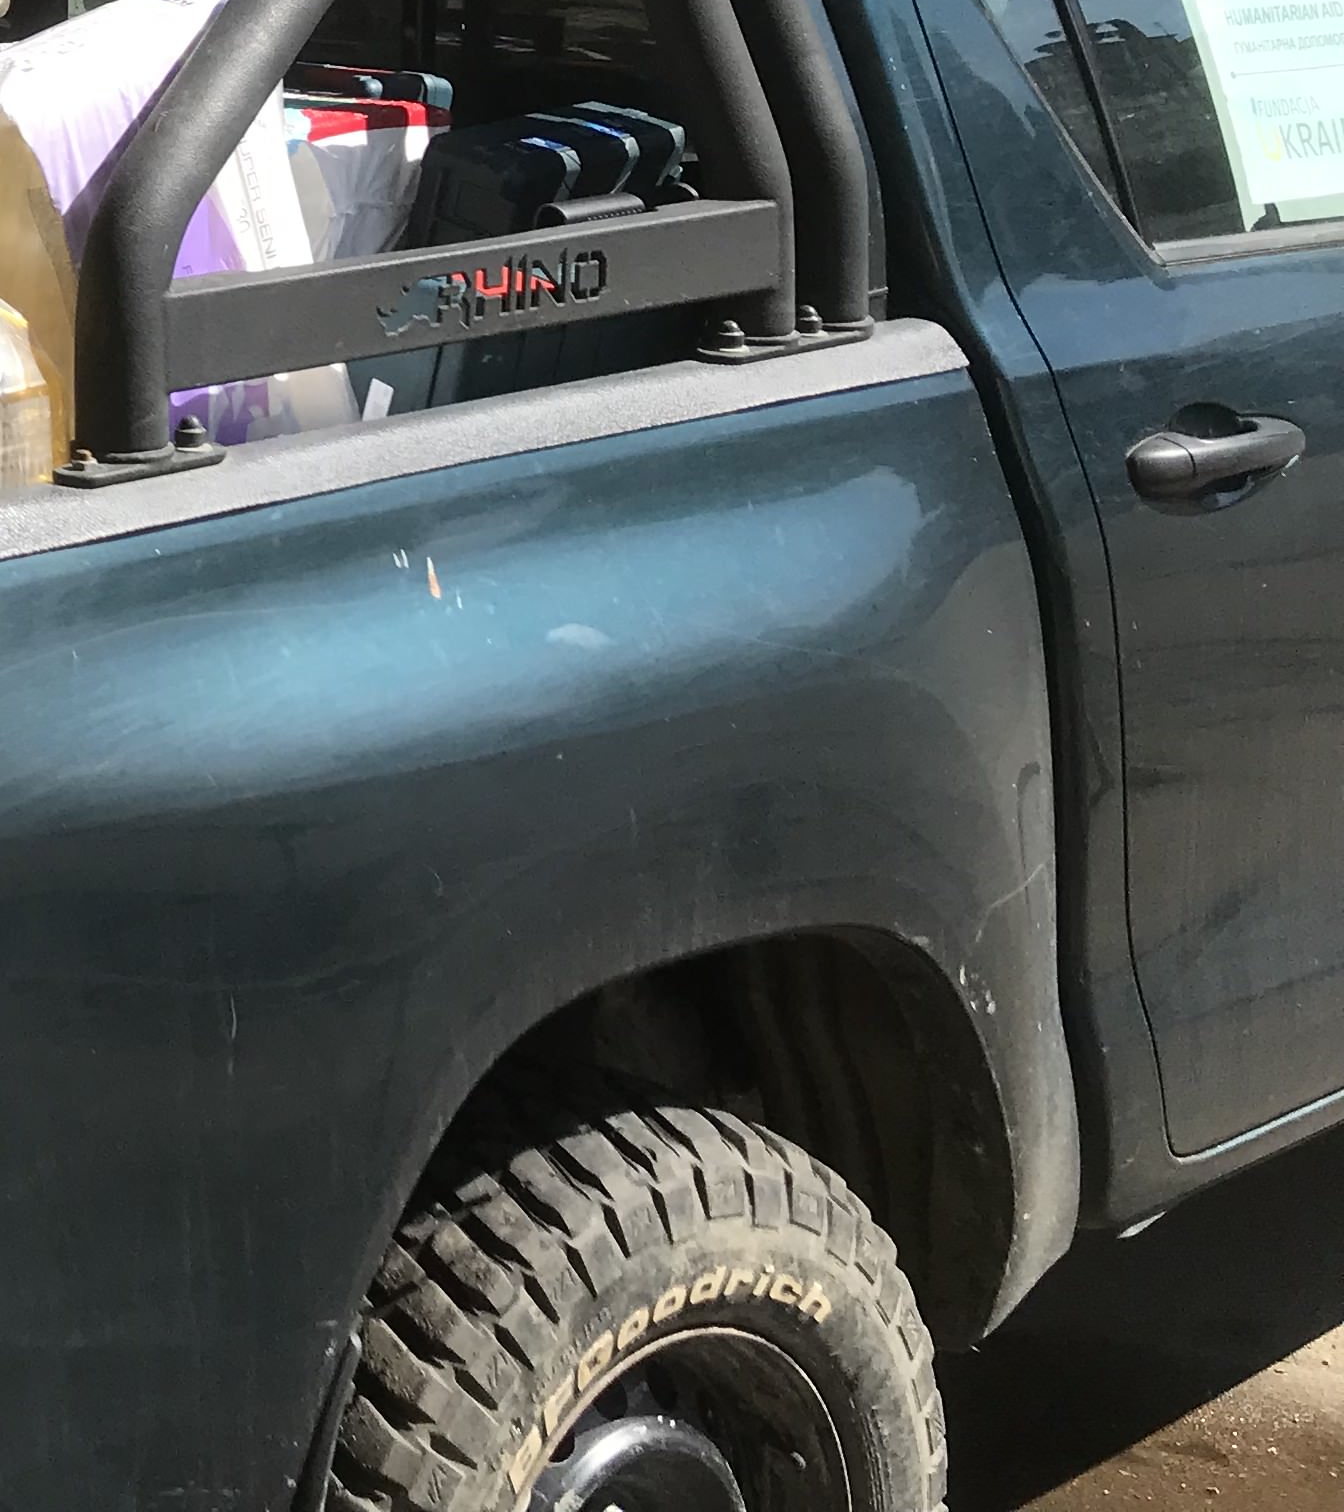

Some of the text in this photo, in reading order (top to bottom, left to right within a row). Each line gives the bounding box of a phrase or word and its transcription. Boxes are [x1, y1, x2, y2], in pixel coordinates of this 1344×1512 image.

[1224, 2, 1319, 26] HUMANITARIAN
[1256, 96, 1320, 117] FUNDACJA
[1257, 117, 1344, 162] UKRAI
[256, 208, 277, 260] SENI
[437, 247, 607, 329] RHINO
[506, 1265, 833, 1494] BFGoodrich
